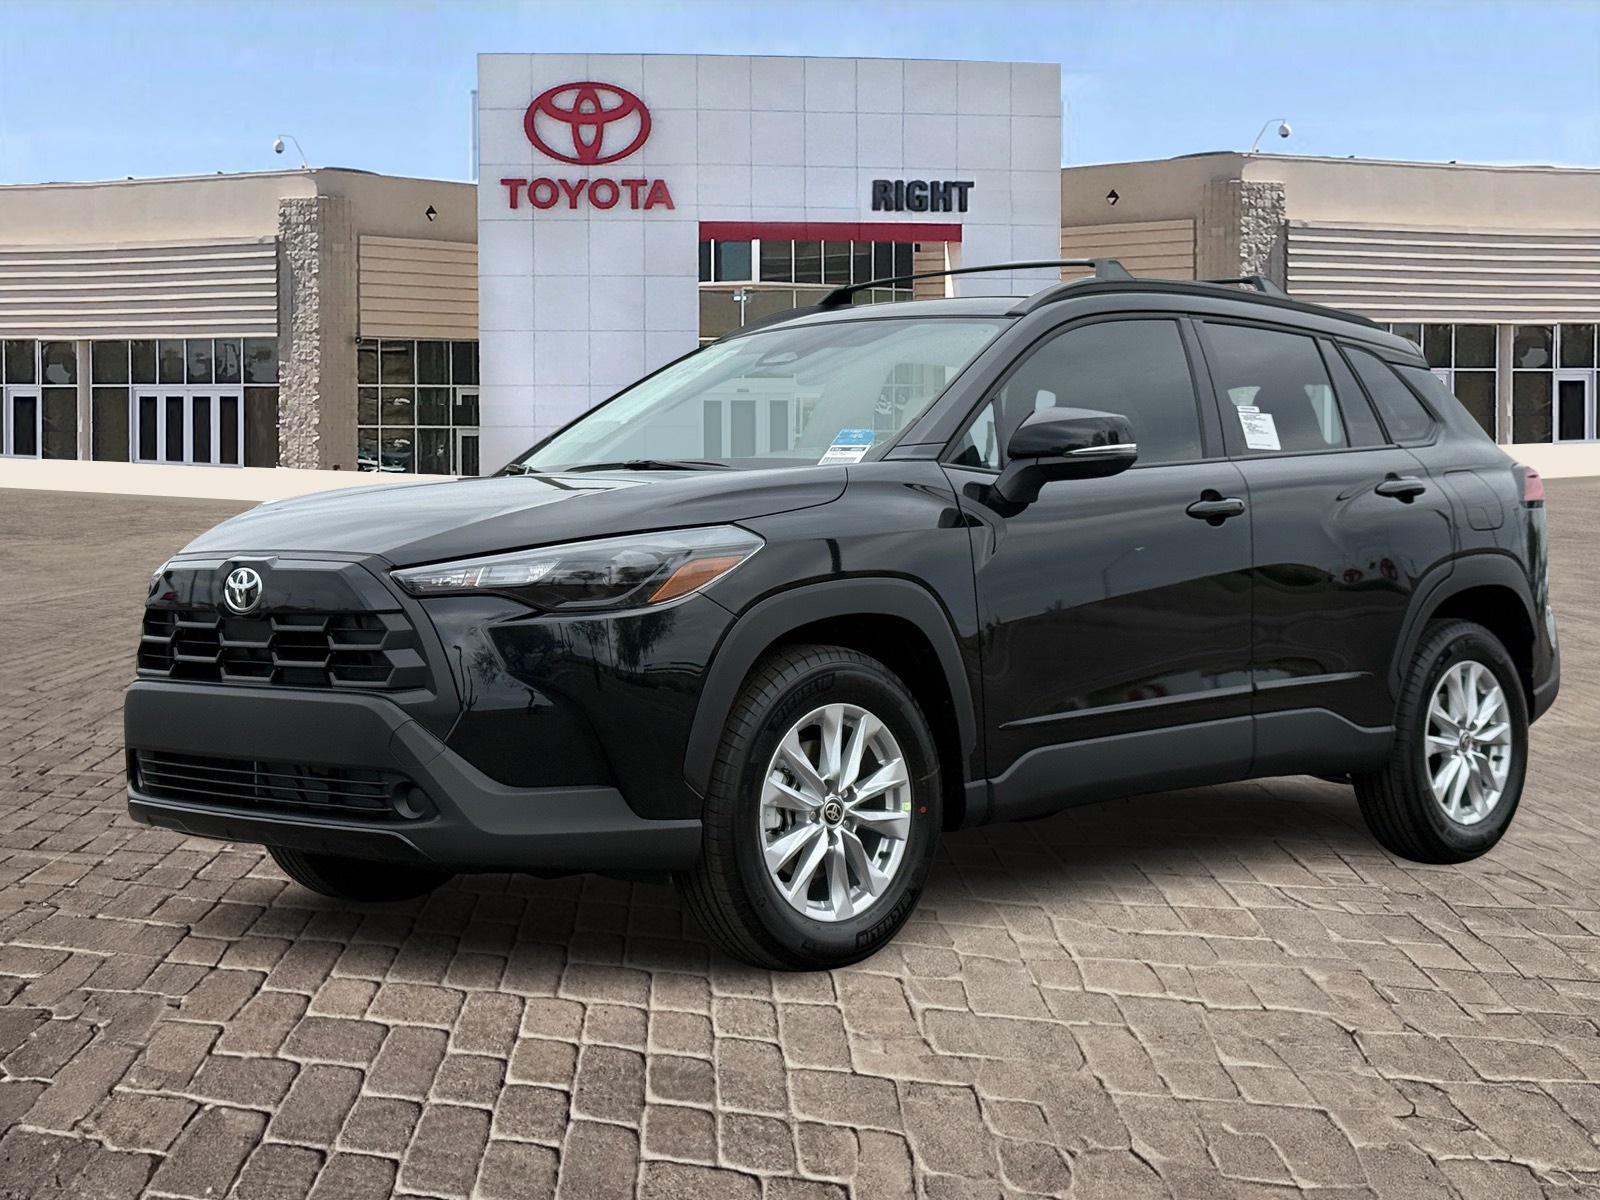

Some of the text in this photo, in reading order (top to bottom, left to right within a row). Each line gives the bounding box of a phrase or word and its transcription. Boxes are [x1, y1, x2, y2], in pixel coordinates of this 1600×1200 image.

[500, 178, 675, 210] TOYOTA
[872, 180, 974, 213] RIGHT
[771, 676, 834, 728] MICHELIN
[859, 892, 915, 946] MICHELIN
